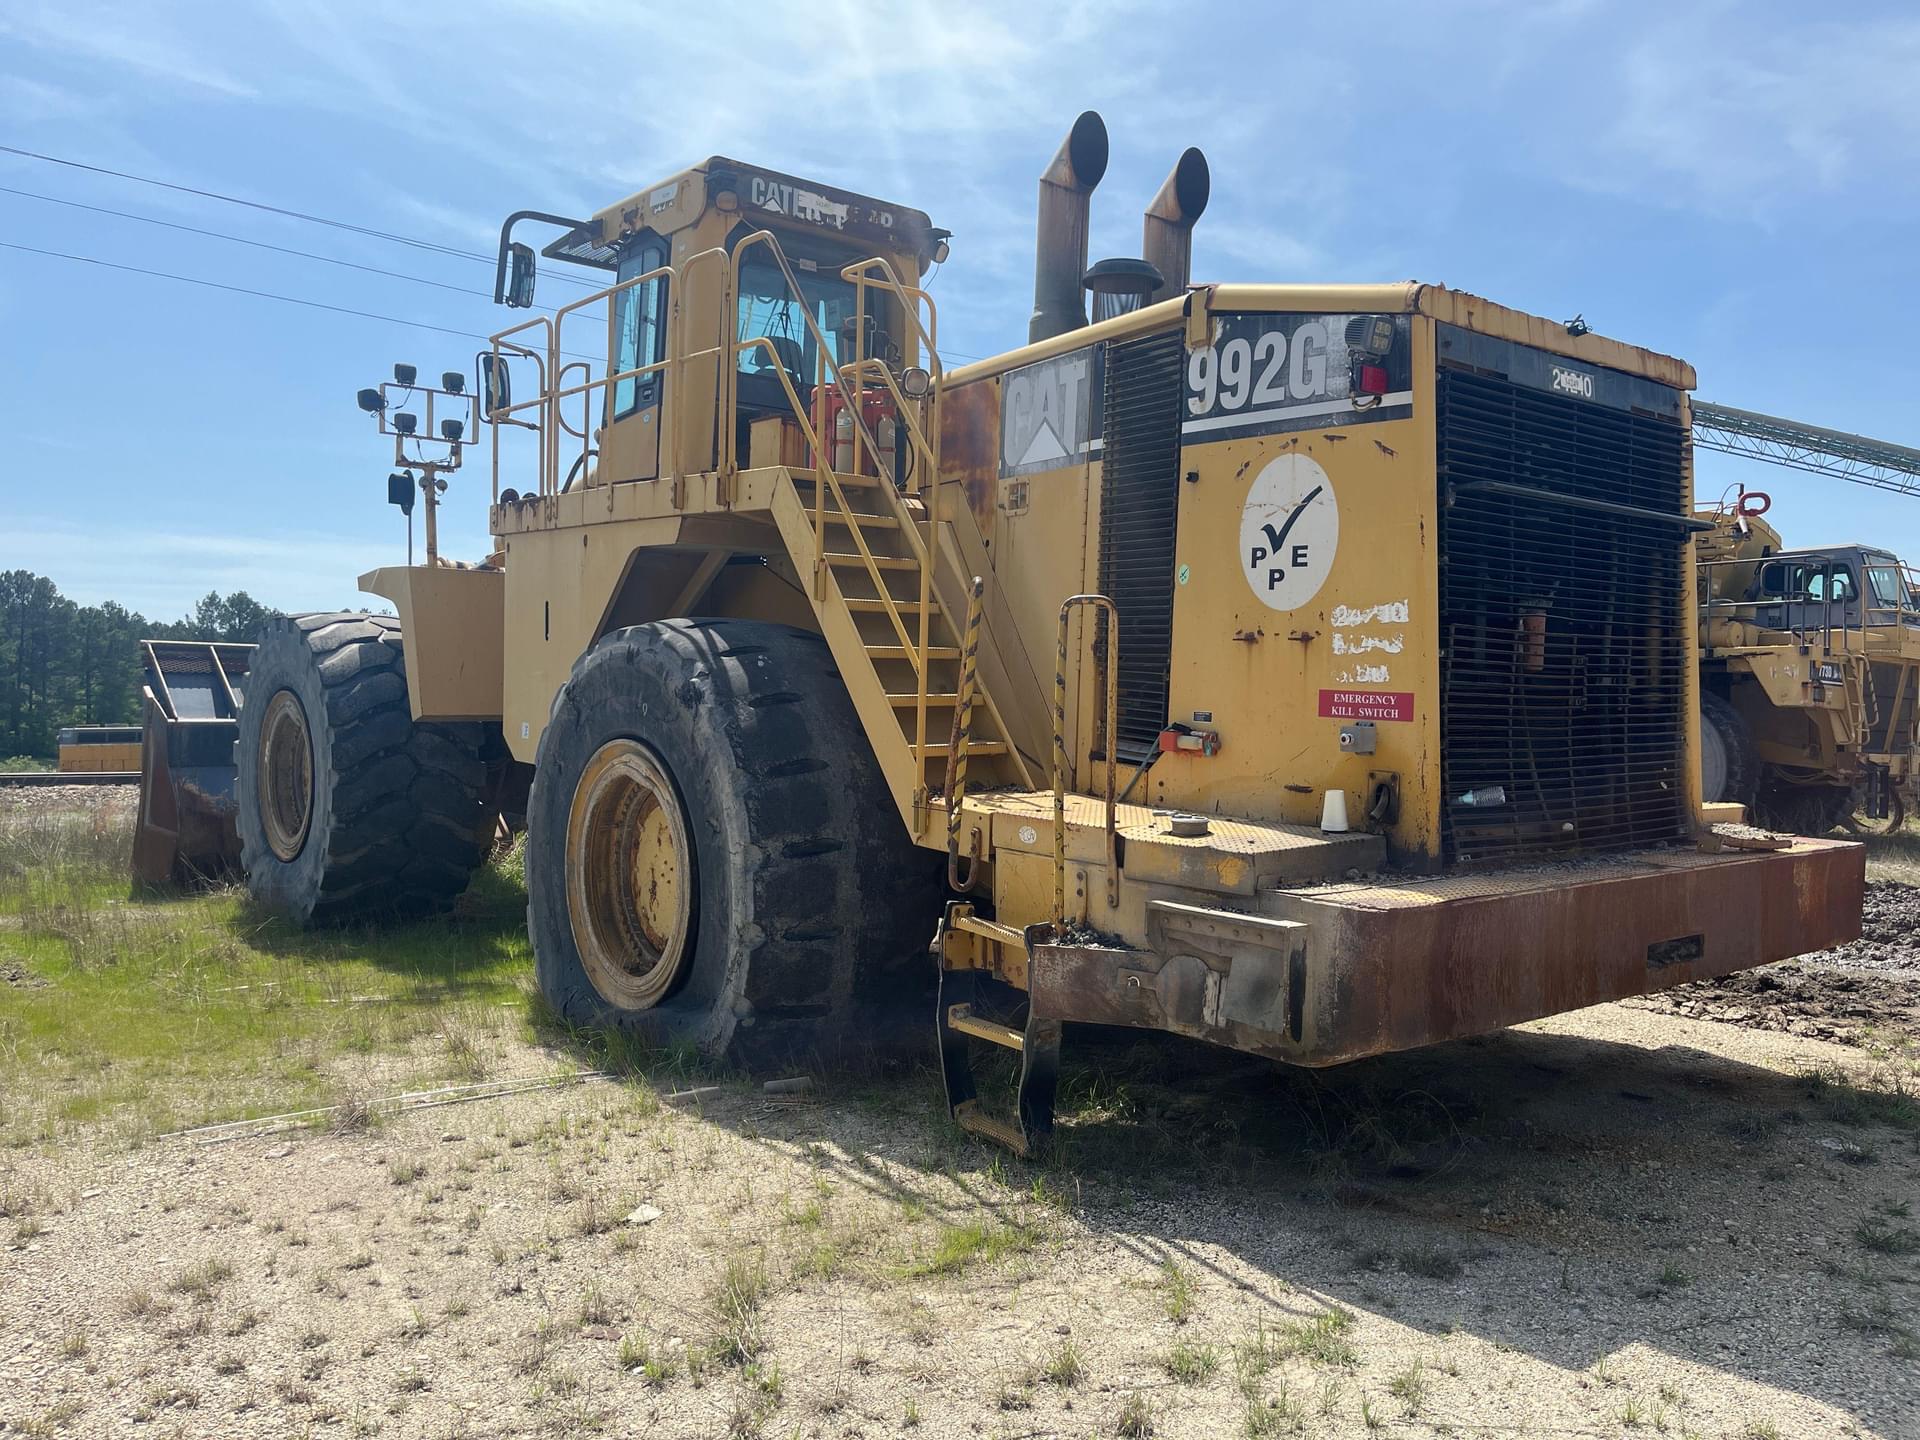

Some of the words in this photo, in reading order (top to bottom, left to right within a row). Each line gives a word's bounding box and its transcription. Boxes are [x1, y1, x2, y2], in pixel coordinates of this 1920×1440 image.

[1187, 322, 1328, 415] 992G
[1004, 359, 1086, 467] CAT
[1331, 706, 1354, 716] KILL
[1358, 707, 1399, 719] SWITCH
[1334, 693, 1397, 705] EMERGENCY
